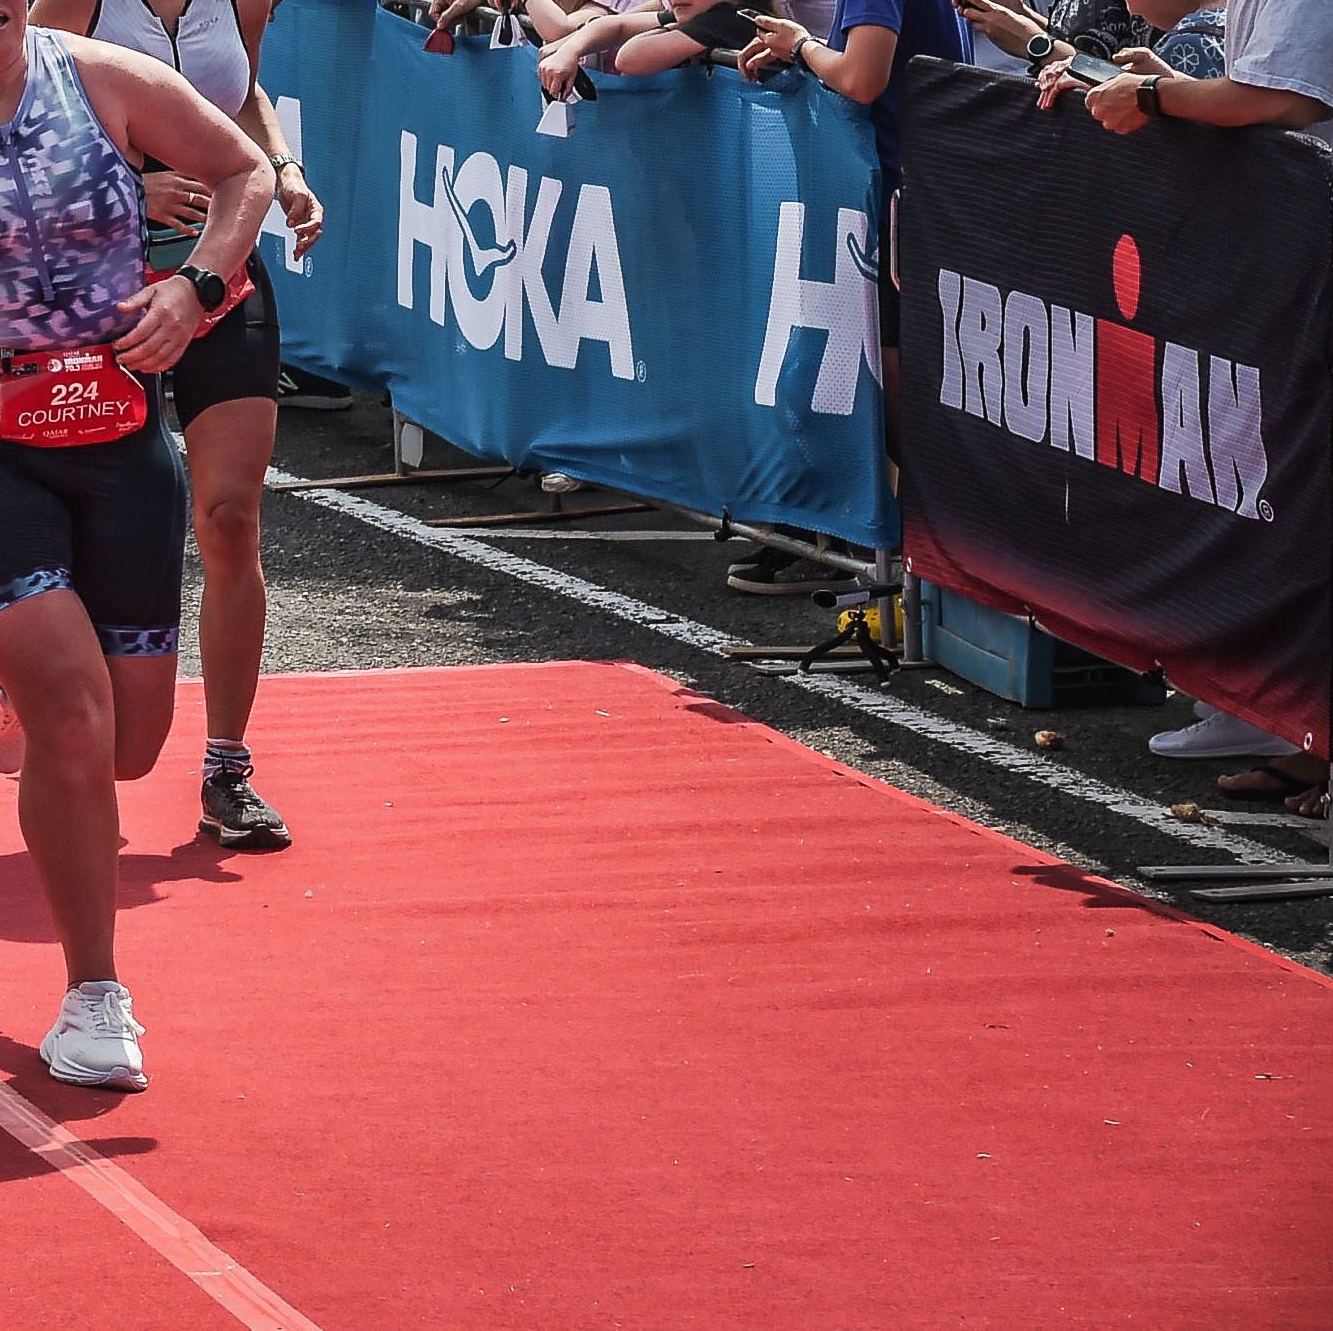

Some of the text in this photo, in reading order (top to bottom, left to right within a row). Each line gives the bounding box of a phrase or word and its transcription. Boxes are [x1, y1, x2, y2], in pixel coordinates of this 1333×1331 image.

[396, 129, 635, 381] HOKA
[17, 400, 130, 427] COURTNEY
[50, 380, 100, 406] 224
[937, 254, 1269, 521] IRONMAN
